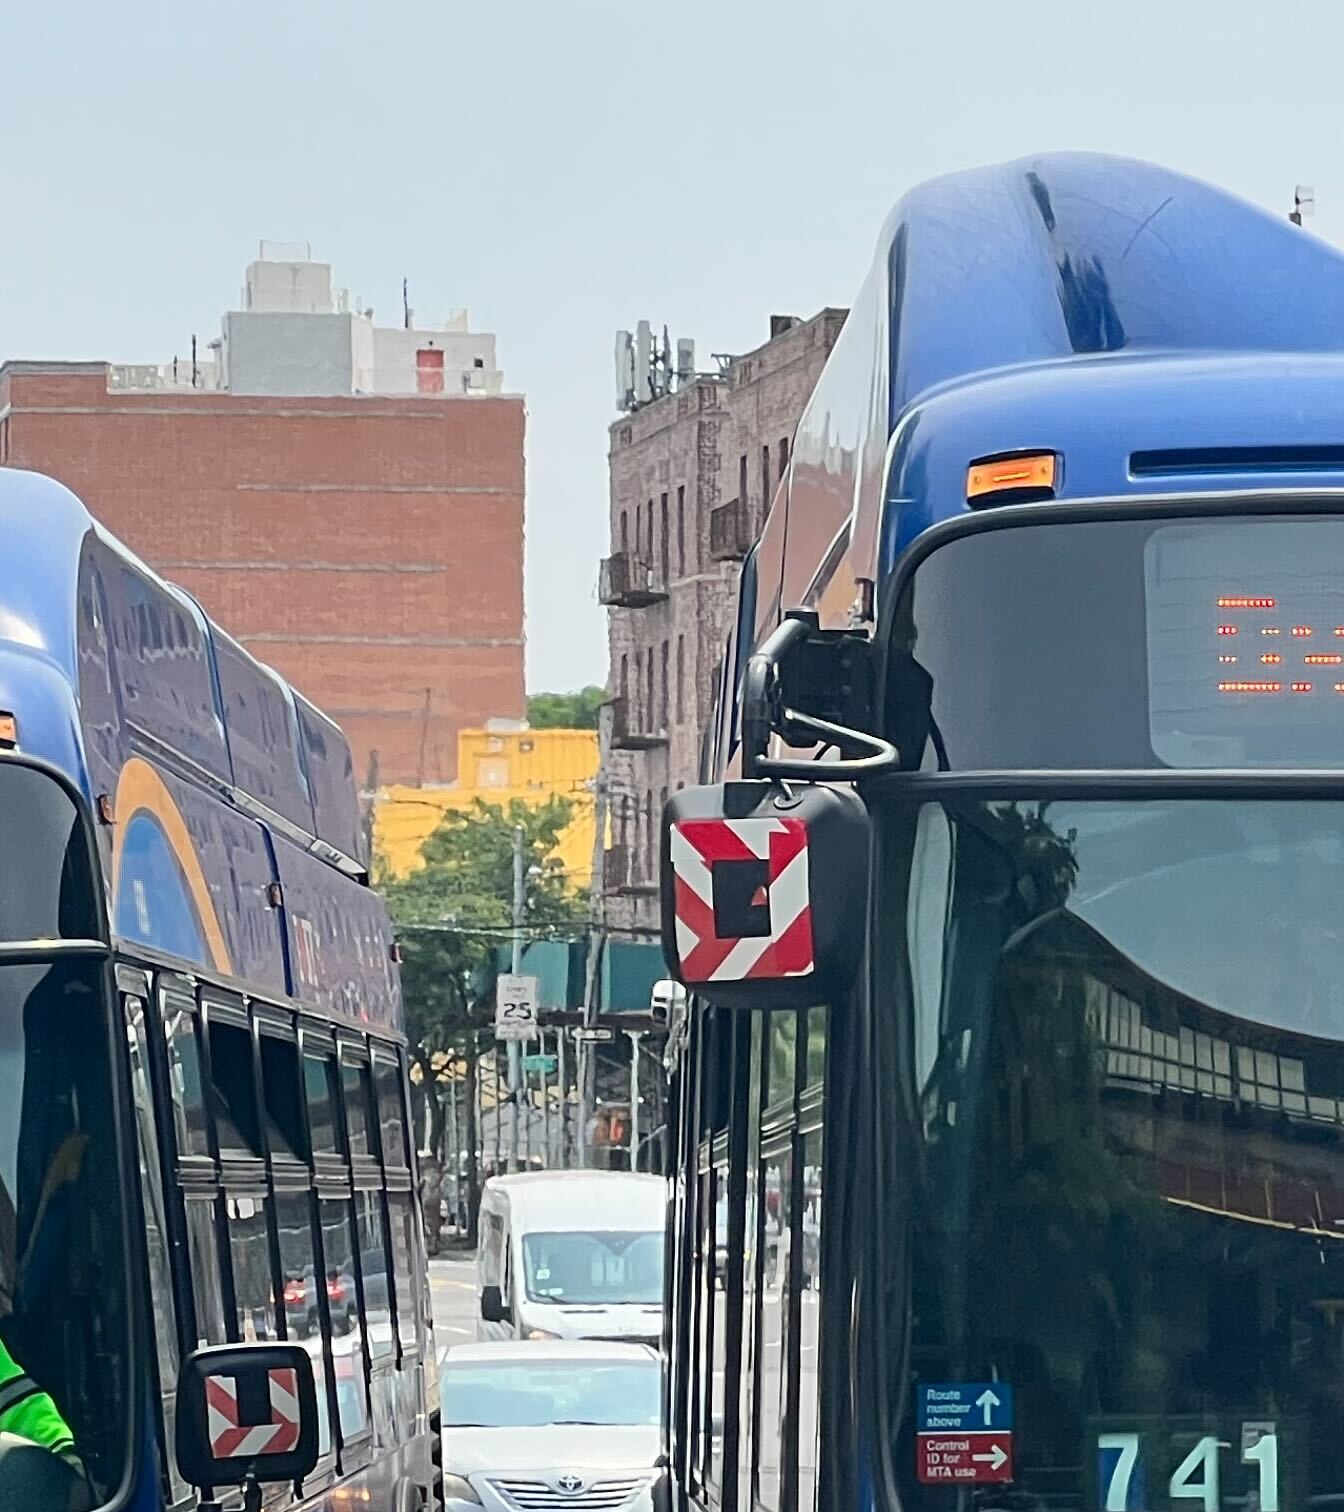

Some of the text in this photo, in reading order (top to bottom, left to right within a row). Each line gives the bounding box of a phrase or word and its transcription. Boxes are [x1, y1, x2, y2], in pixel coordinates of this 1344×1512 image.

[503, 1002, 532, 1020] 25
[926, 1388, 961, 1401] Route
[926, 1403, 971, 1414] number
[926, 1416, 962, 1427] above
[926, 1439, 970, 1451] Control
[926, 1453, 961, 1464] ID for
[926, 1466, 977, 1477] MTA use
